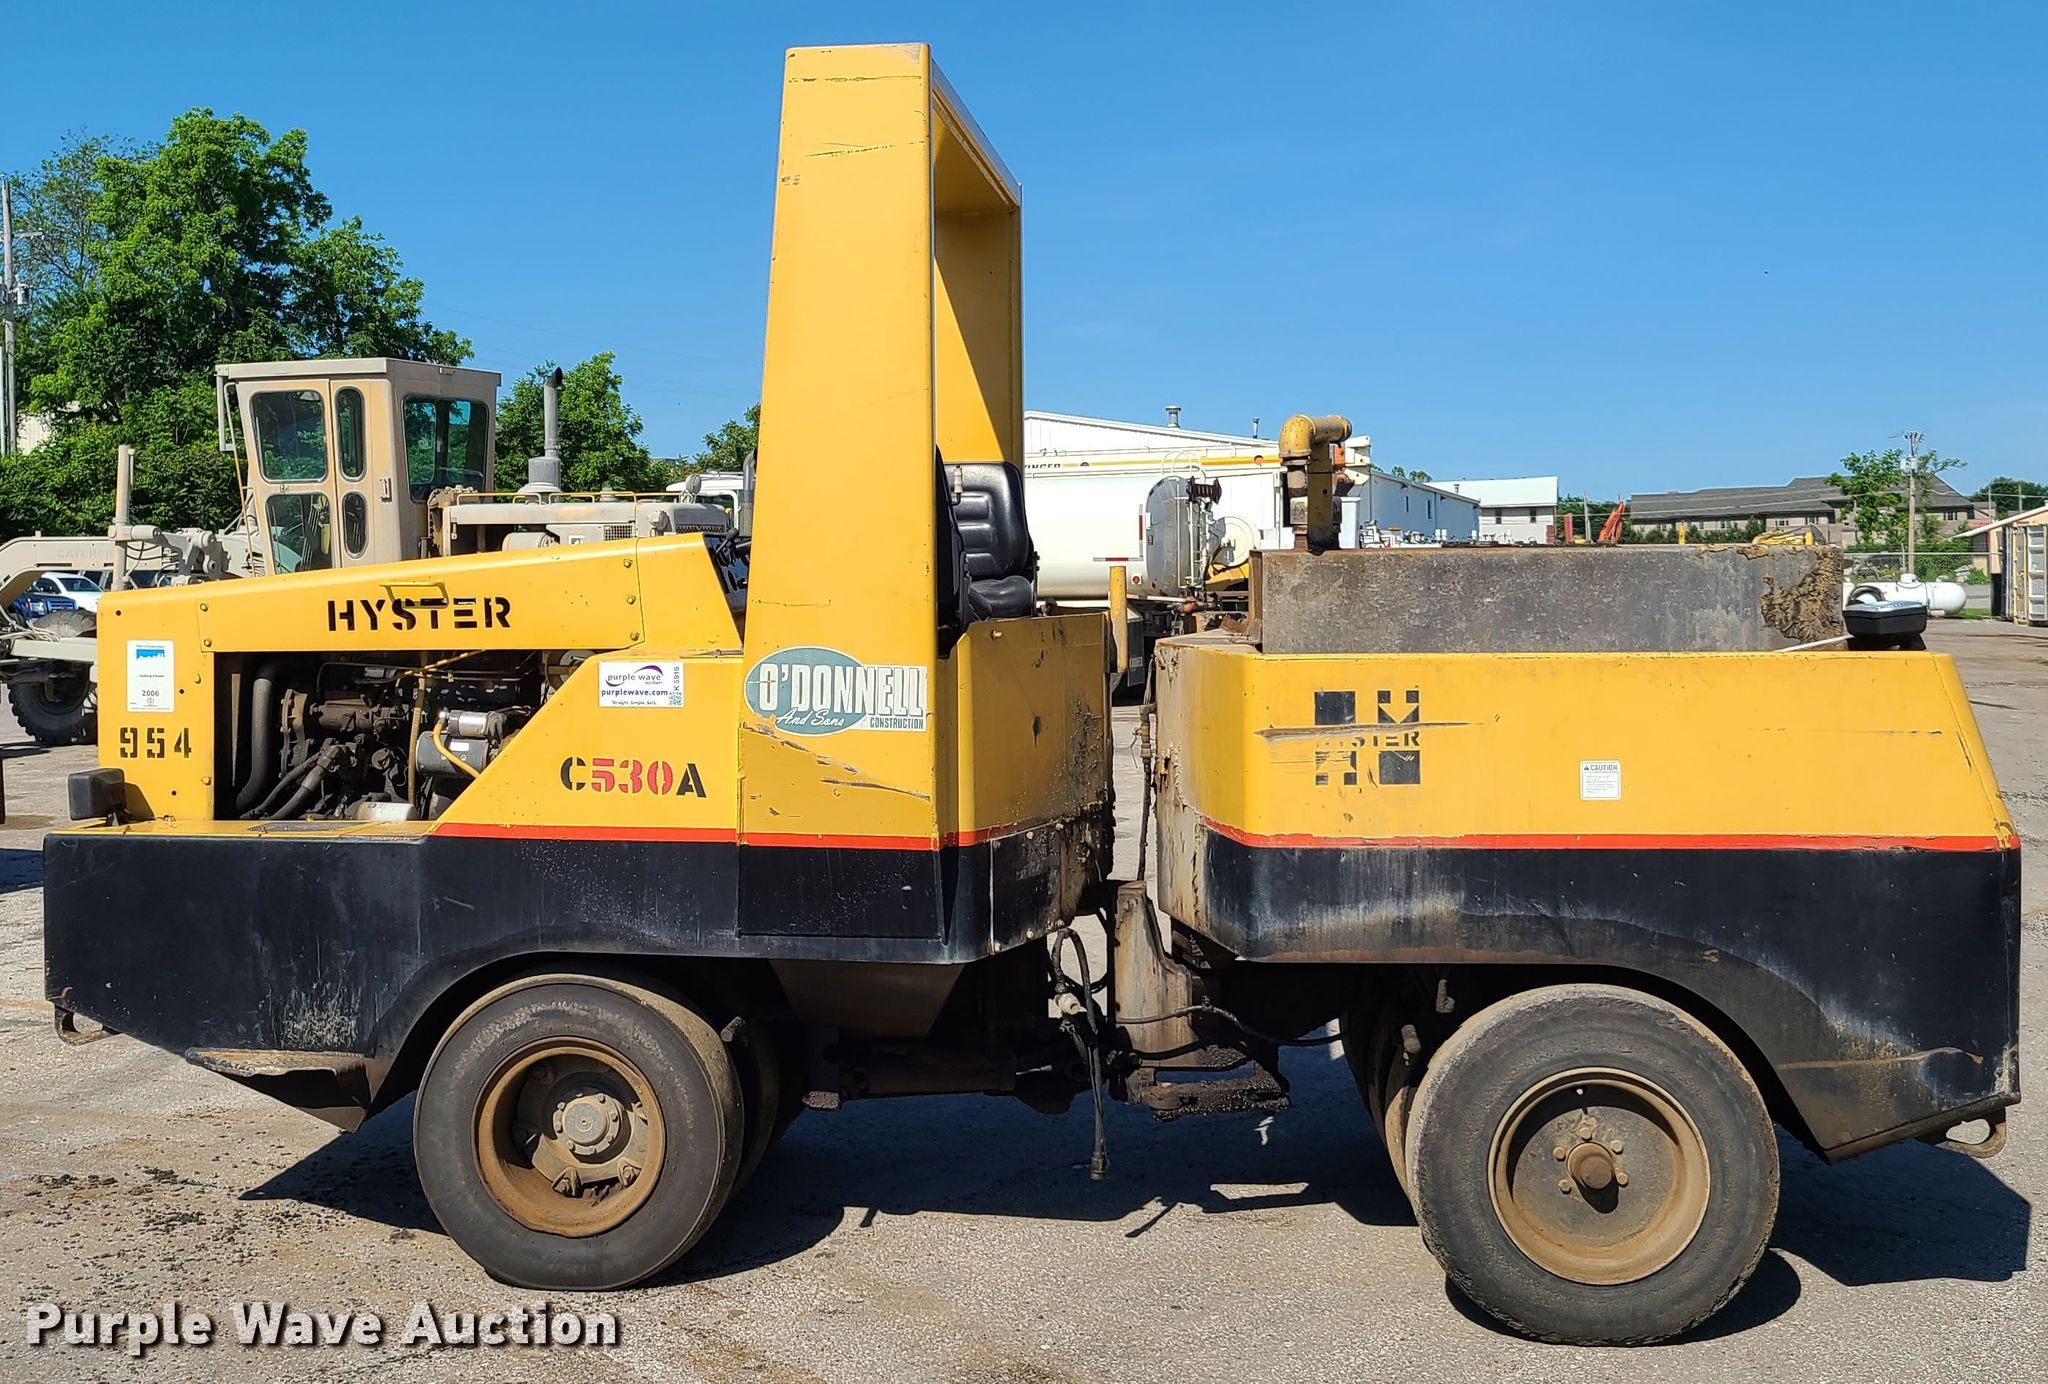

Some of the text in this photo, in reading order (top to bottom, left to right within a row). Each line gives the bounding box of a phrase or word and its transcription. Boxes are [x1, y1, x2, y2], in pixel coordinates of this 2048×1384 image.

[327, 596, 511, 631] HYSTER
[607, 674, 636, 683] purple
[141, 689, 160, 697] 2006
[601, 688, 668, 697] purplewave.com
[759, 663, 924, 716] O'DONNELL
[777, 707, 845, 726] And Sons
[869, 716, 924, 730] CONSTRUCTION
[119, 727, 192, 759] 954
[560, 756, 707, 798] C530A
